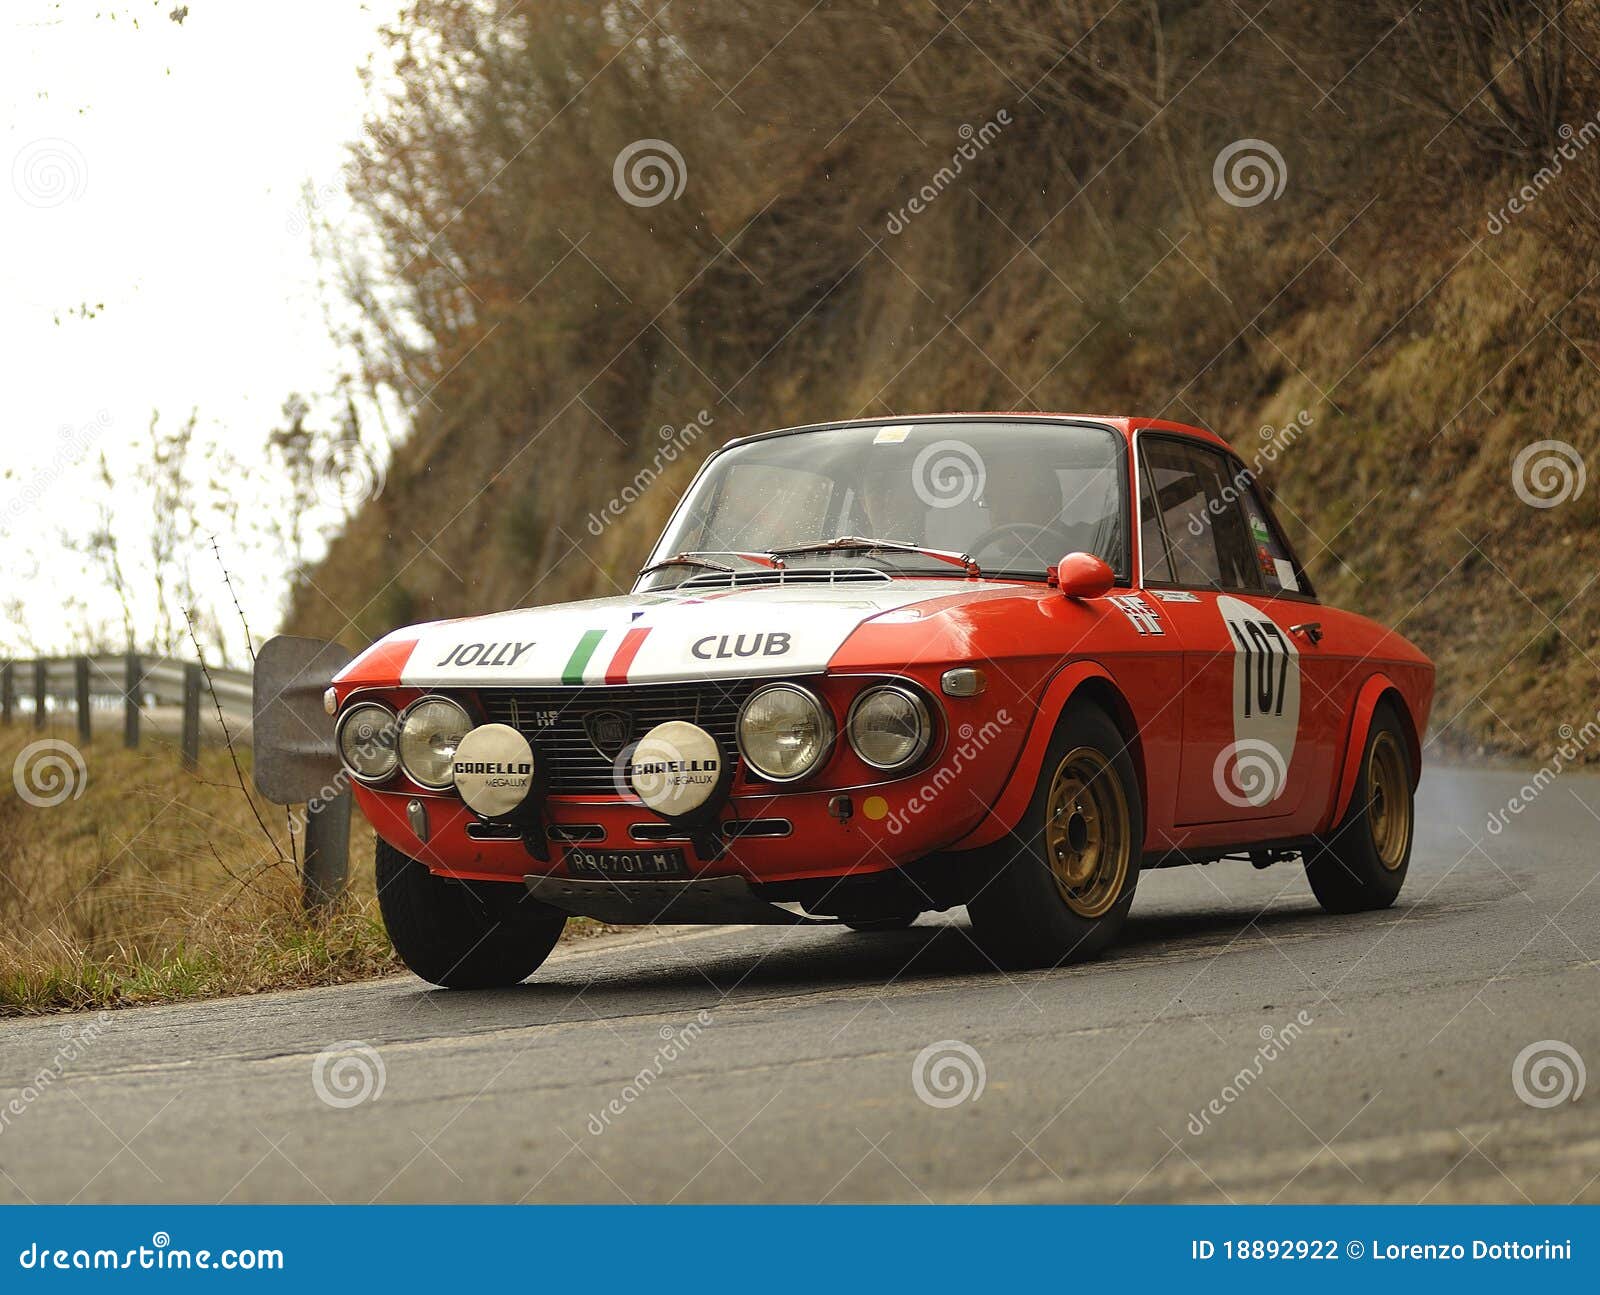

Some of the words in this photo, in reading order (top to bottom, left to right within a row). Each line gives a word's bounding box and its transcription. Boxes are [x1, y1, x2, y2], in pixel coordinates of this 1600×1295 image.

[437, 642, 536, 667] JOLLY
[691, 632, 791, 660] CLUB
[1227, 619, 1290, 718] 107
